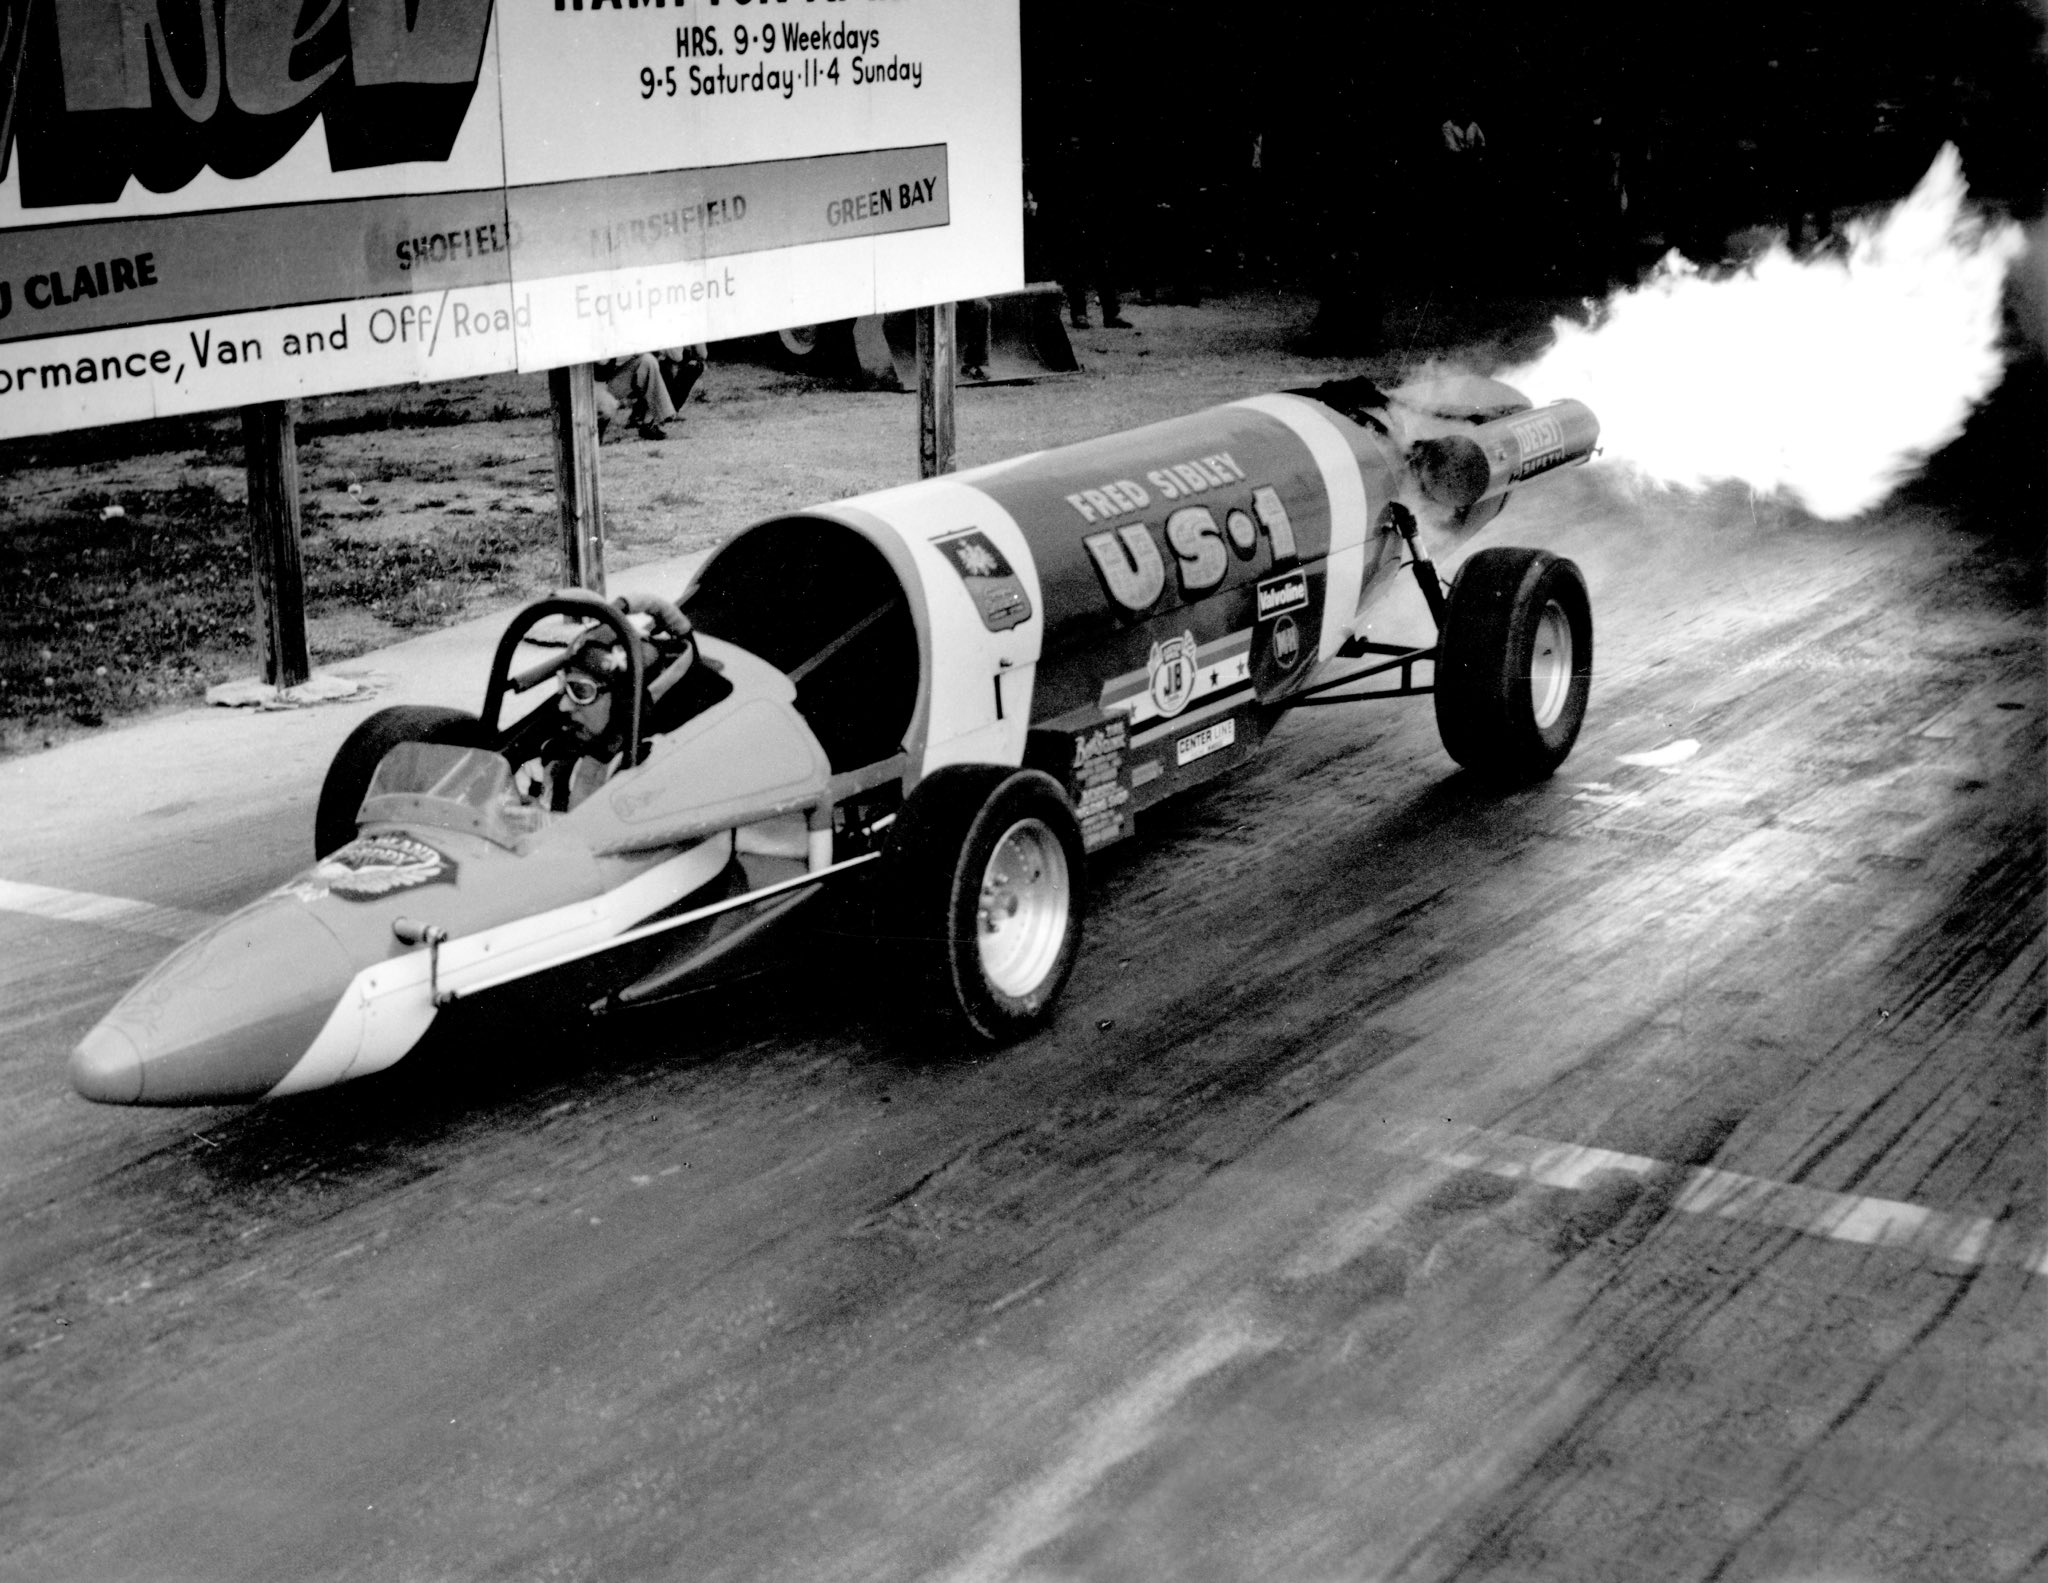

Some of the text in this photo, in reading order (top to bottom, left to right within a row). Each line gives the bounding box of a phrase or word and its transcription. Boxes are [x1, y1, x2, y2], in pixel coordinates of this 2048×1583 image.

[676, 25, 723, 57] HRS.
[782, 20, 879, 54] Weekdays
[850, 55, 922, 88] Sunday
[826, 176, 937, 227] GREEN BAY
[24, 252, 158, 310] CLAIRE
[190, 329, 262, 368] Van
[282, 313, 349, 356] and
[573, 265, 736, 325] Equipment
[1066, 452, 1246, 524] FRED SIBLEY
[1260, 582, 1305, 611] Valvoline
[1180, 729, 1212, 754] CENTER
